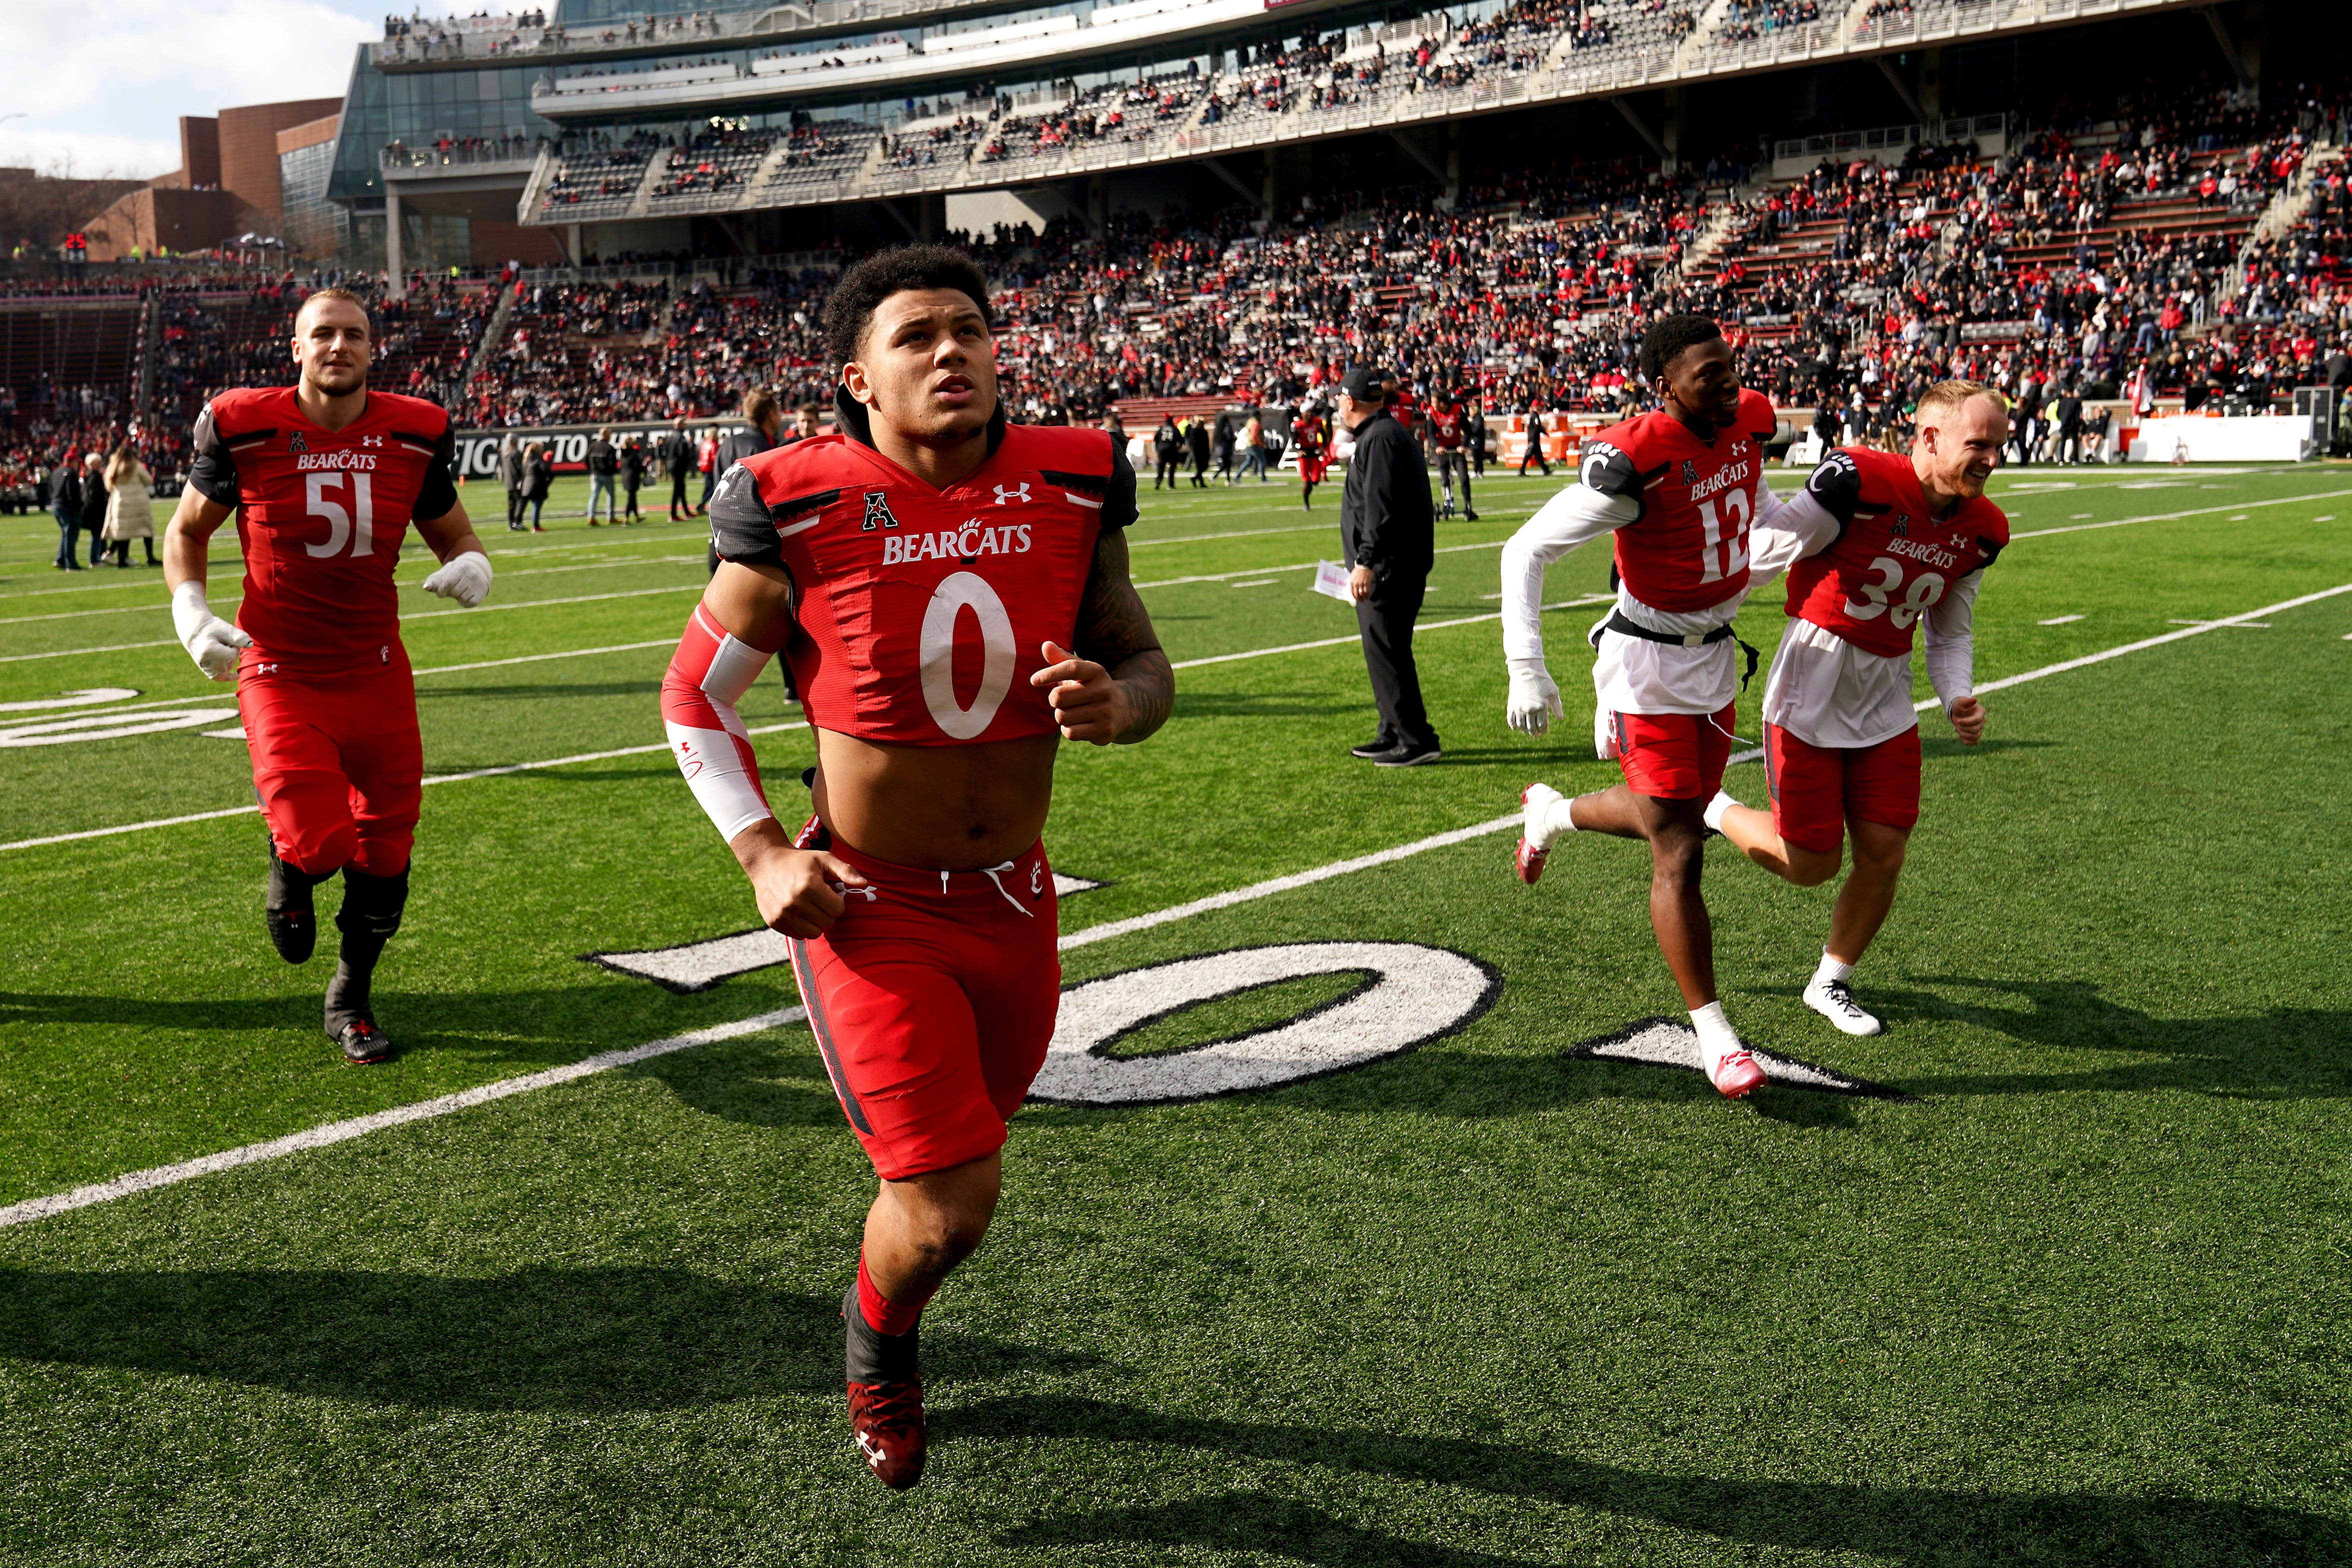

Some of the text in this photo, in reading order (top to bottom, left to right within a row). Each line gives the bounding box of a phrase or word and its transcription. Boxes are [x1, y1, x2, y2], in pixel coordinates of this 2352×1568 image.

[66, 233, 86, 248] 25
[297, 452, 376, 470] BEARCATS
[552, 434, 588, 463] TO
[1691, 460, 1748, 502] BEARCATS
[304, 472, 374, 558] 51
[1697, 488, 1750, 584] 12
[882, 524, 1032, 566] BEARCATS
[1886, 538, 1956, 568] BEARCATS
[1844, 557, 1945, 630] 38
[920, 571, 1016, 740] 0
